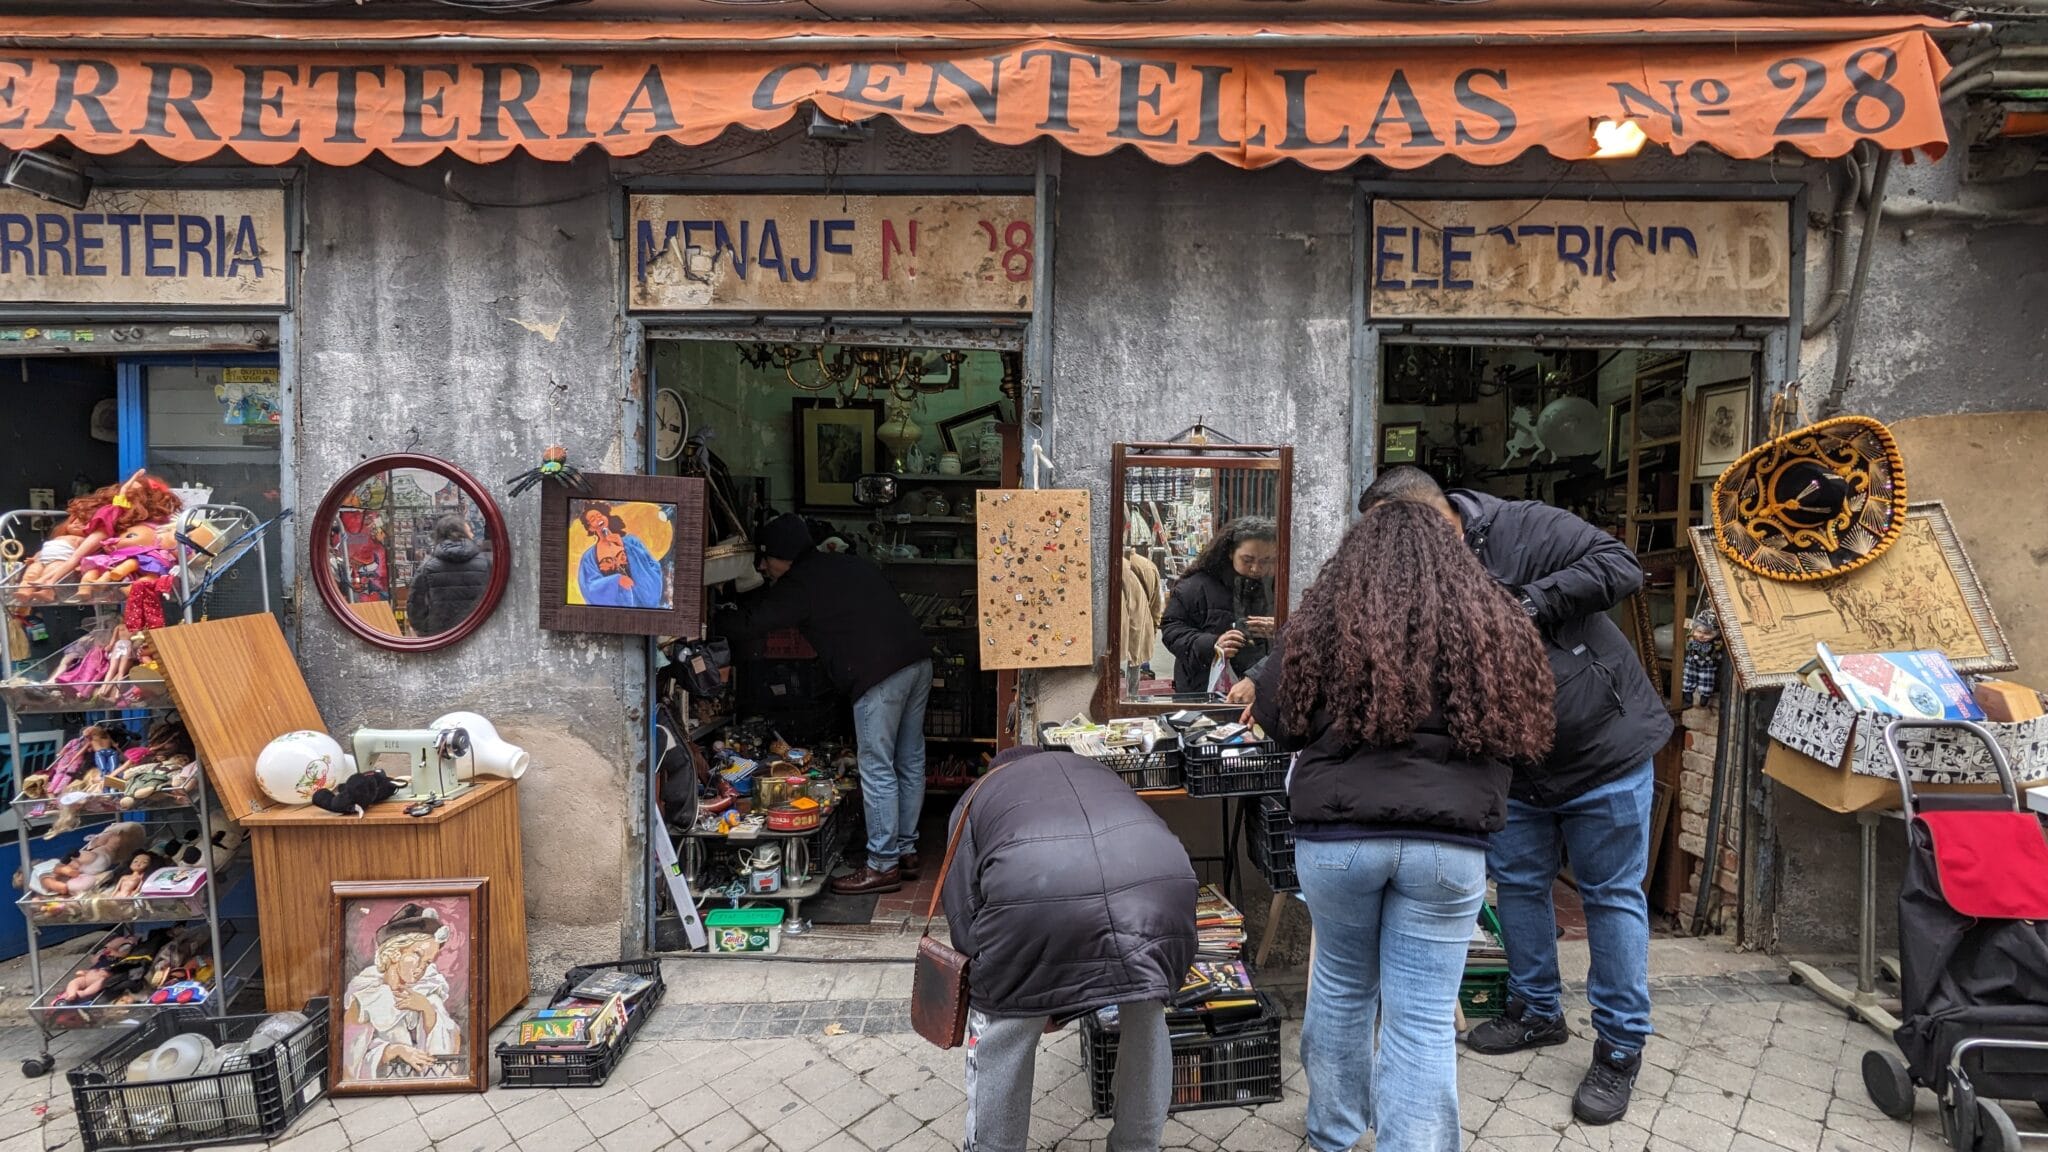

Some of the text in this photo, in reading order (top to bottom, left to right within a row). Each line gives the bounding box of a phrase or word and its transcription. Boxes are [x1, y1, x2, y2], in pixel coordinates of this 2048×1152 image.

[752, 49, 1517, 149] CENTELLAS
[1766, 46, 1906, 134] 28
[1, 213, 264, 278] RRETERIA
